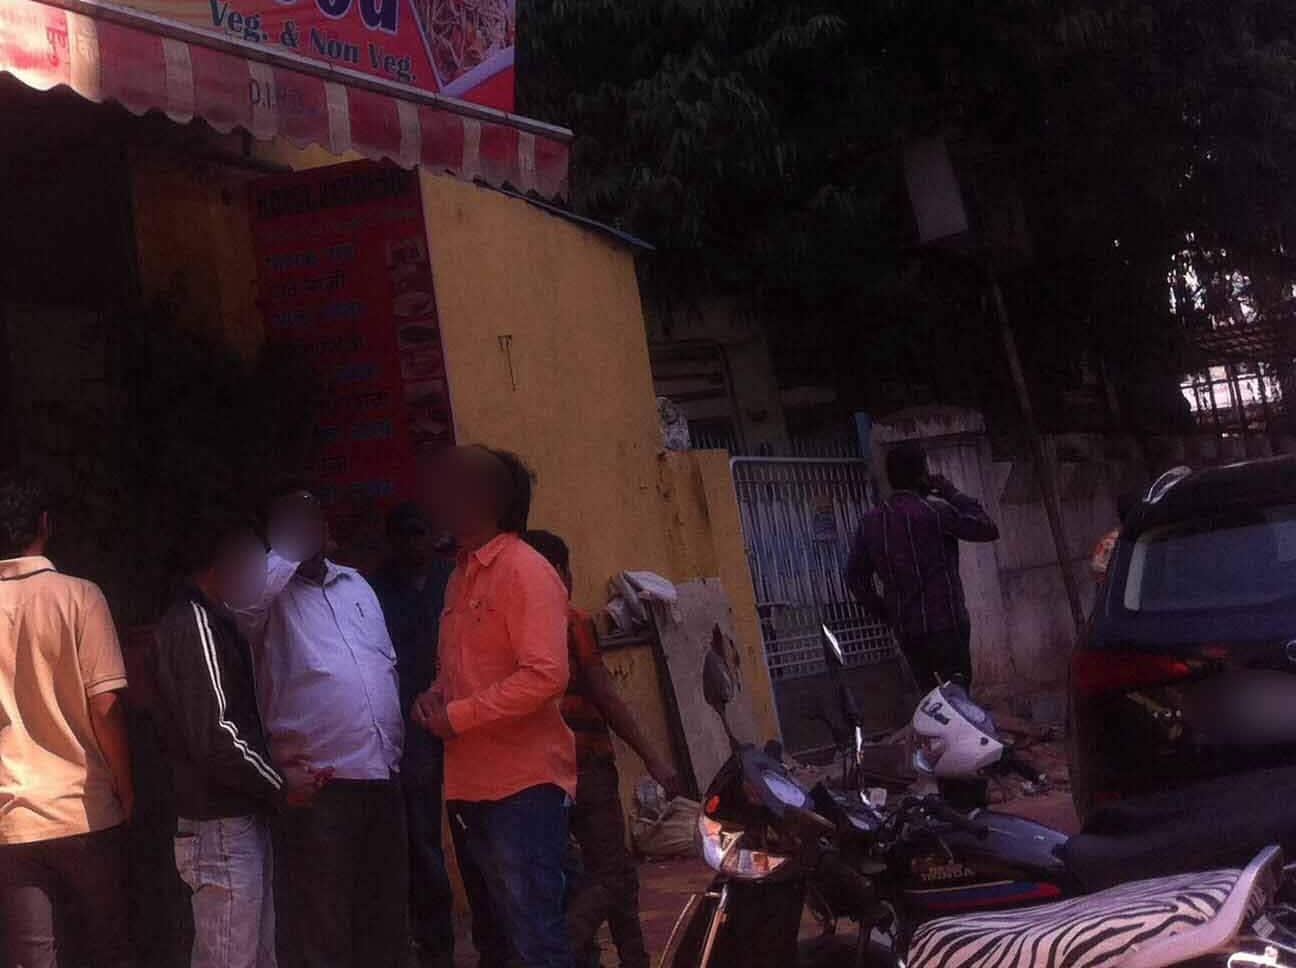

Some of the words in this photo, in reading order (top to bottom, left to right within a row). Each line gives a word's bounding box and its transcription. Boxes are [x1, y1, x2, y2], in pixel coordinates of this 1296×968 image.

[280, 20, 299, 49] &
[311, 28, 361, 65] Non
[369, 43, 417, 82] Veg.
